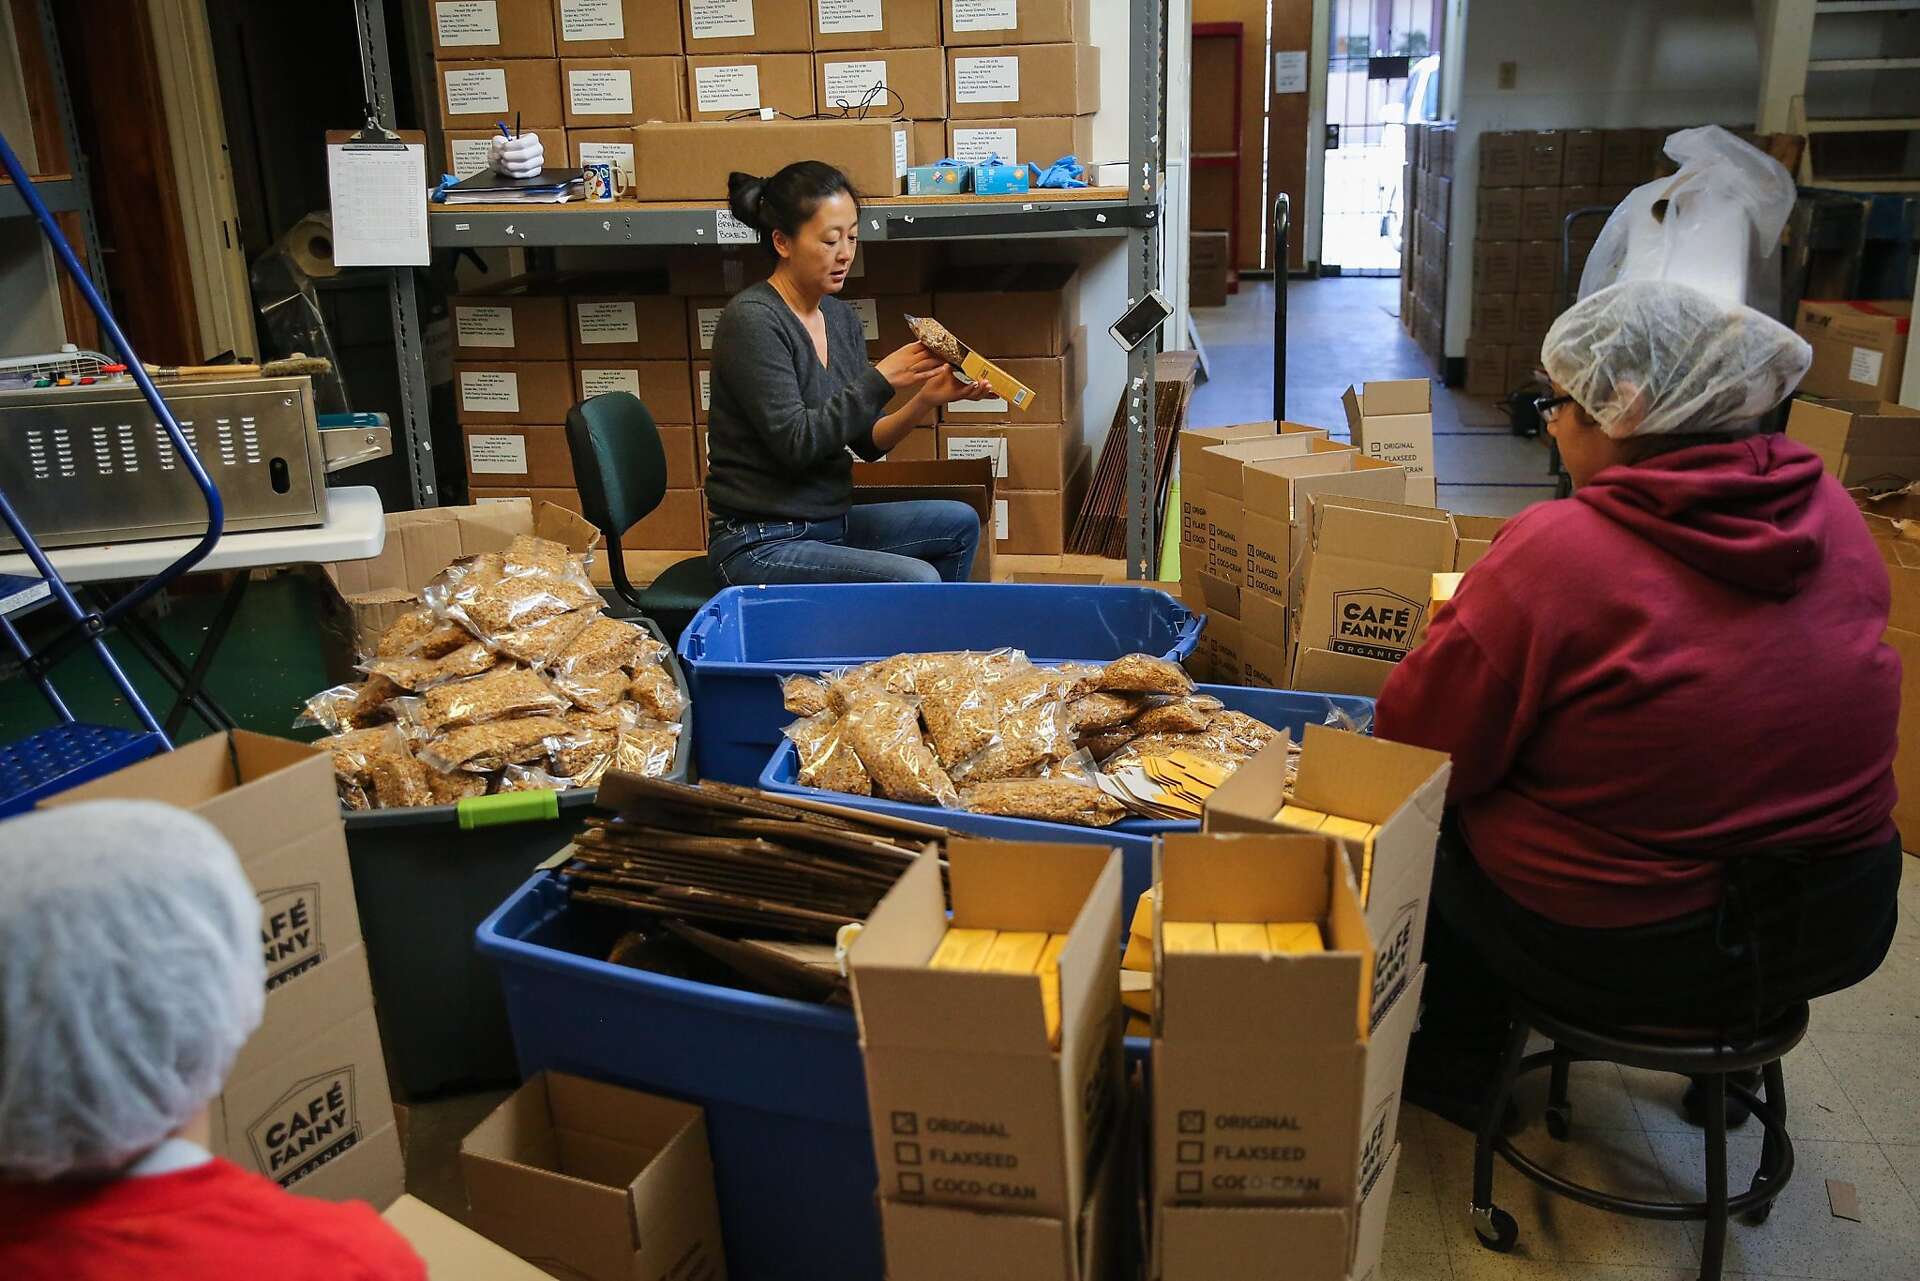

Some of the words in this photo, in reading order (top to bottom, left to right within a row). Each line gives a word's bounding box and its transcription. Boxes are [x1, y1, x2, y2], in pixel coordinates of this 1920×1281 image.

[1383, 442, 1415, 450] ORIGINAL
[1384, 454, 1418, 462] FLAXSEED
[1254, 549, 1278, 565] ORIGINAL
[1255, 564, 1279, 580] FLAXSEED
[1255, 580, 1283, 597] COCO-CRAN
[1343, 603, 1410, 628] CAFÉ
[1337, 644, 1402, 661] ORGANIC
[264, 928, 311, 966] NNY
[1376, 914, 1412, 978] CAFÉ
[266, 1080, 345, 1149] CAFÉ
[1214, 1114, 1302, 1132] ORIGINAL
[927, 1117, 1010, 1138] ORIGINAL
[269, 1107, 347, 1172] FANNY
[929, 1147, 1019, 1169] FLAXSEED
[1213, 1145, 1306, 1162] FLAXSEED
[932, 1177, 1038, 1200] COCO-CRAN
[1211, 1173, 1321, 1192] COCO-CRAN
